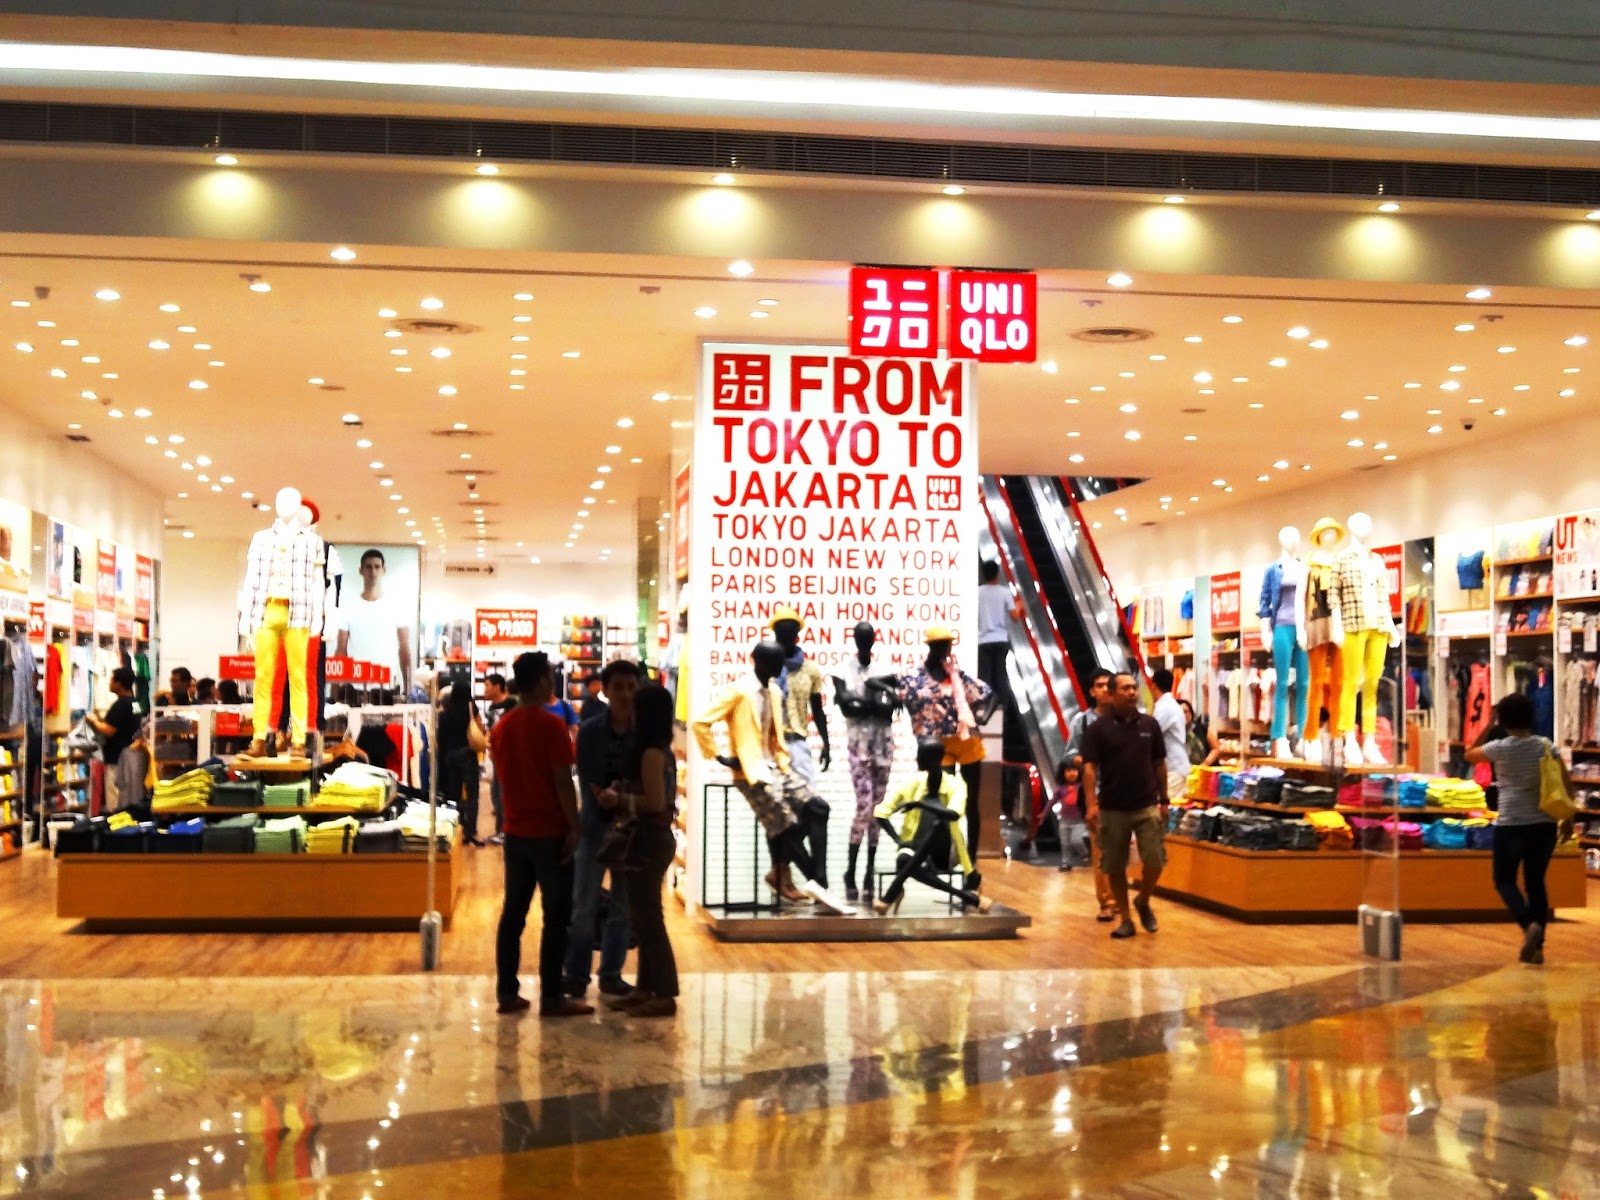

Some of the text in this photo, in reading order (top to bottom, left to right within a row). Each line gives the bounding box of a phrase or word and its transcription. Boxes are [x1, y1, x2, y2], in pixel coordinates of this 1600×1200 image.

[960, 282, 1023, 315] UNI
[960, 317, 1029, 354] QLO
[790, 353, 963, 417] FROM
[712, 416, 962, 469] TOKYO TO
[712, 470, 918, 510] JAKARTA
[928, 476, 957, 493] UNI
[928, 493, 959, 510] QLO
[712, 513, 960, 543] TOKYO JAKARTA
[1556, 515, 1578, 551] UT
[711, 546, 960, 571] LONDON NEW YORK
[711, 573, 960, 597] PARIS BEIJING SEOUL
[837, 602, 894, 621] HONG
[906, 603, 961, 622] KONG
[711, 625, 961, 647] TAIPE AN FANCIO
